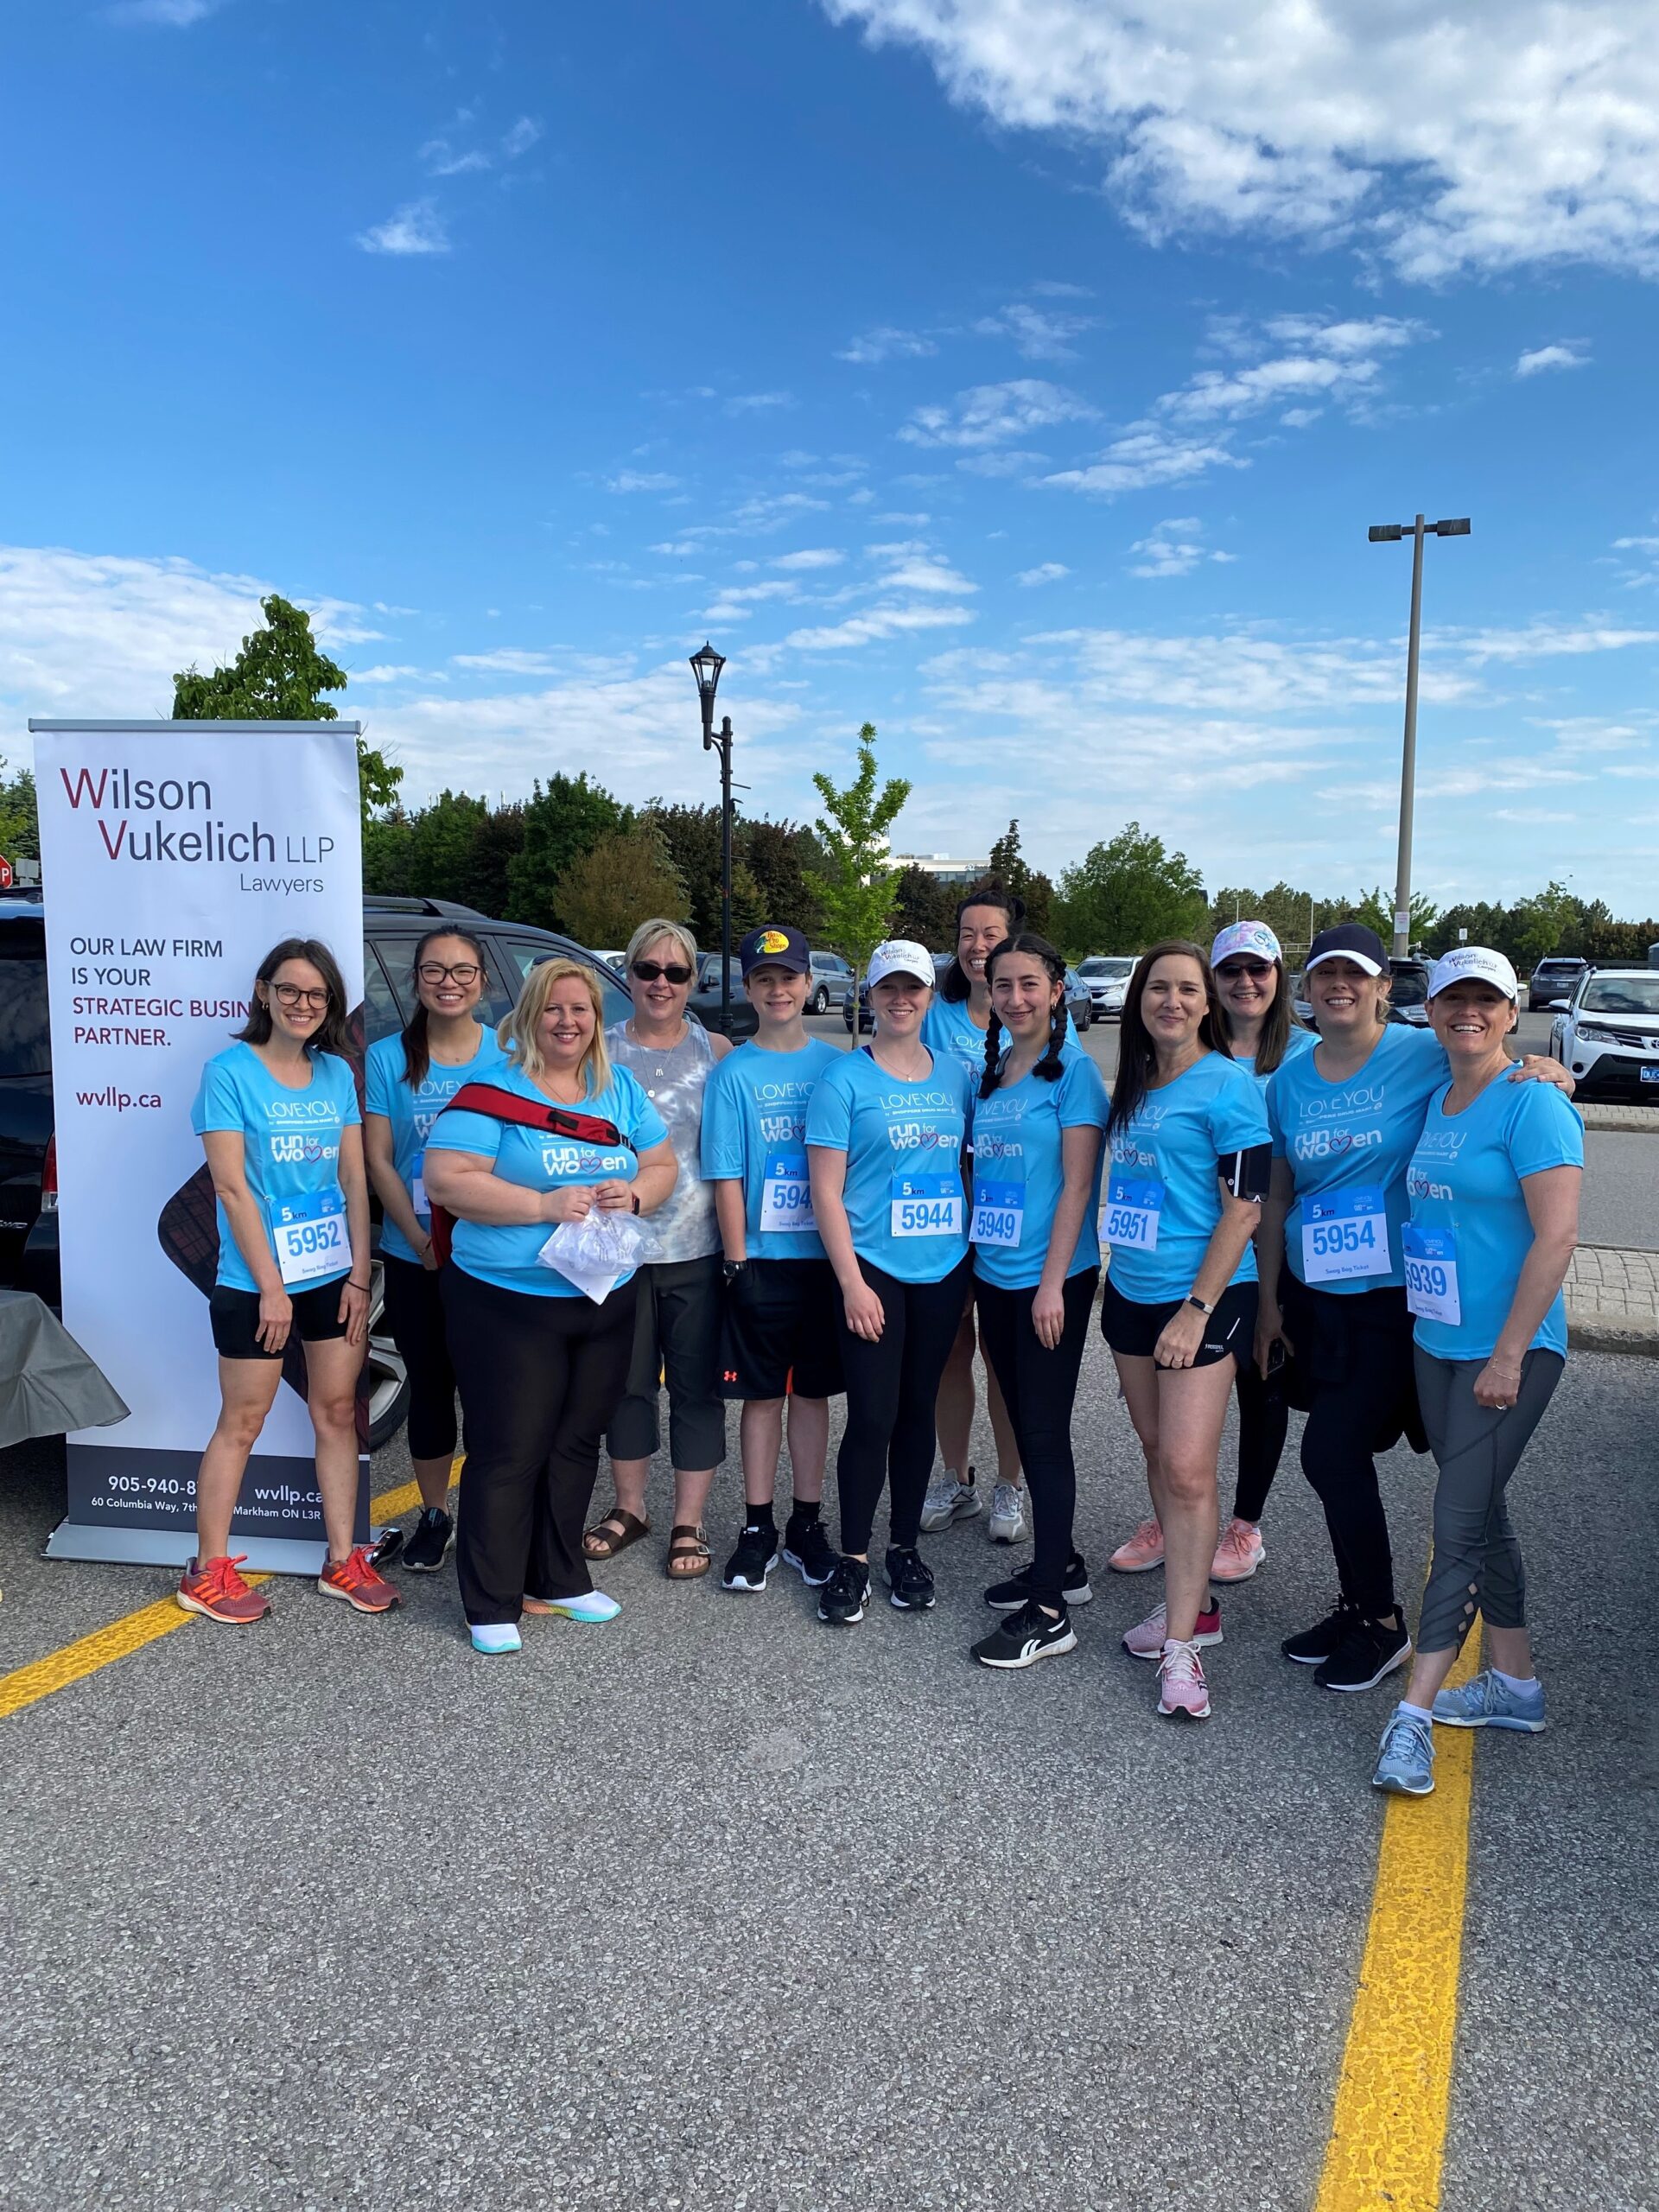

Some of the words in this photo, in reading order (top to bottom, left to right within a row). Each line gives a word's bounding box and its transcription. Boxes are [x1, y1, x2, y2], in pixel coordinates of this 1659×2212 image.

[60, 768, 212, 810] Wilson
[98, 820, 275, 862] Vukelich
[287, 836, 334, 862] LLP
[240, 874, 324, 895] Lawyers
[70, 938, 114, 955] OUR
[121, 938, 166, 956] LAW
[173, 939, 223, 957] FIRM
[72, 967, 87, 984] IS
[93, 968, 150, 986] YOUR
[73, 997, 183, 1016] STRATEGIC
[190, 1000, 251, 1018] BUSIN
[74, 1027, 171, 1046] PARTNER.
[76, 1086, 162, 1112] wvllp.ca
[754, 1082, 816, 1101] LOVEYO
[760, 1116, 791, 1131] run
[888, 1122, 920, 1139] run
[922, 1123, 937, 1134] for
[270, 1135, 303, 1149] run
[306, 1135, 320, 1146] for
[1294, 1129, 1330, 1148] run
[1333, 1128, 1351, 1138] for
[542, 1147, 579, 1163] run
[581, 1147, 596, 1158] for
[773, 1185, 813, 1210] 594
[901, 1202, 953, 1230] 5944
[977, 1211, 1016, 1240] 5949
[1108, 1210, 1148, 1242] 5951
[287, 1220, 341, 1257] 5952
[1313, 1219, 1376, 1255] 5954
[1404, 1261, 1447, 1297] 5939
[108, 1476, 198, 1496] 905-940-8
[255, 1484, 323, 1505] wvllp.ca
[92, 1497, 104, 1507] 60
[106, 1498, 152, 1510] Columbia
[155, 1501, 180, 1513] Way,
[181, 1503, 198, 1512] 7th
[233, 1506, 279, 1518] Markham
[282, 1509, 299, 1519] ON
[302, 1510, 321, 1520] L3R
